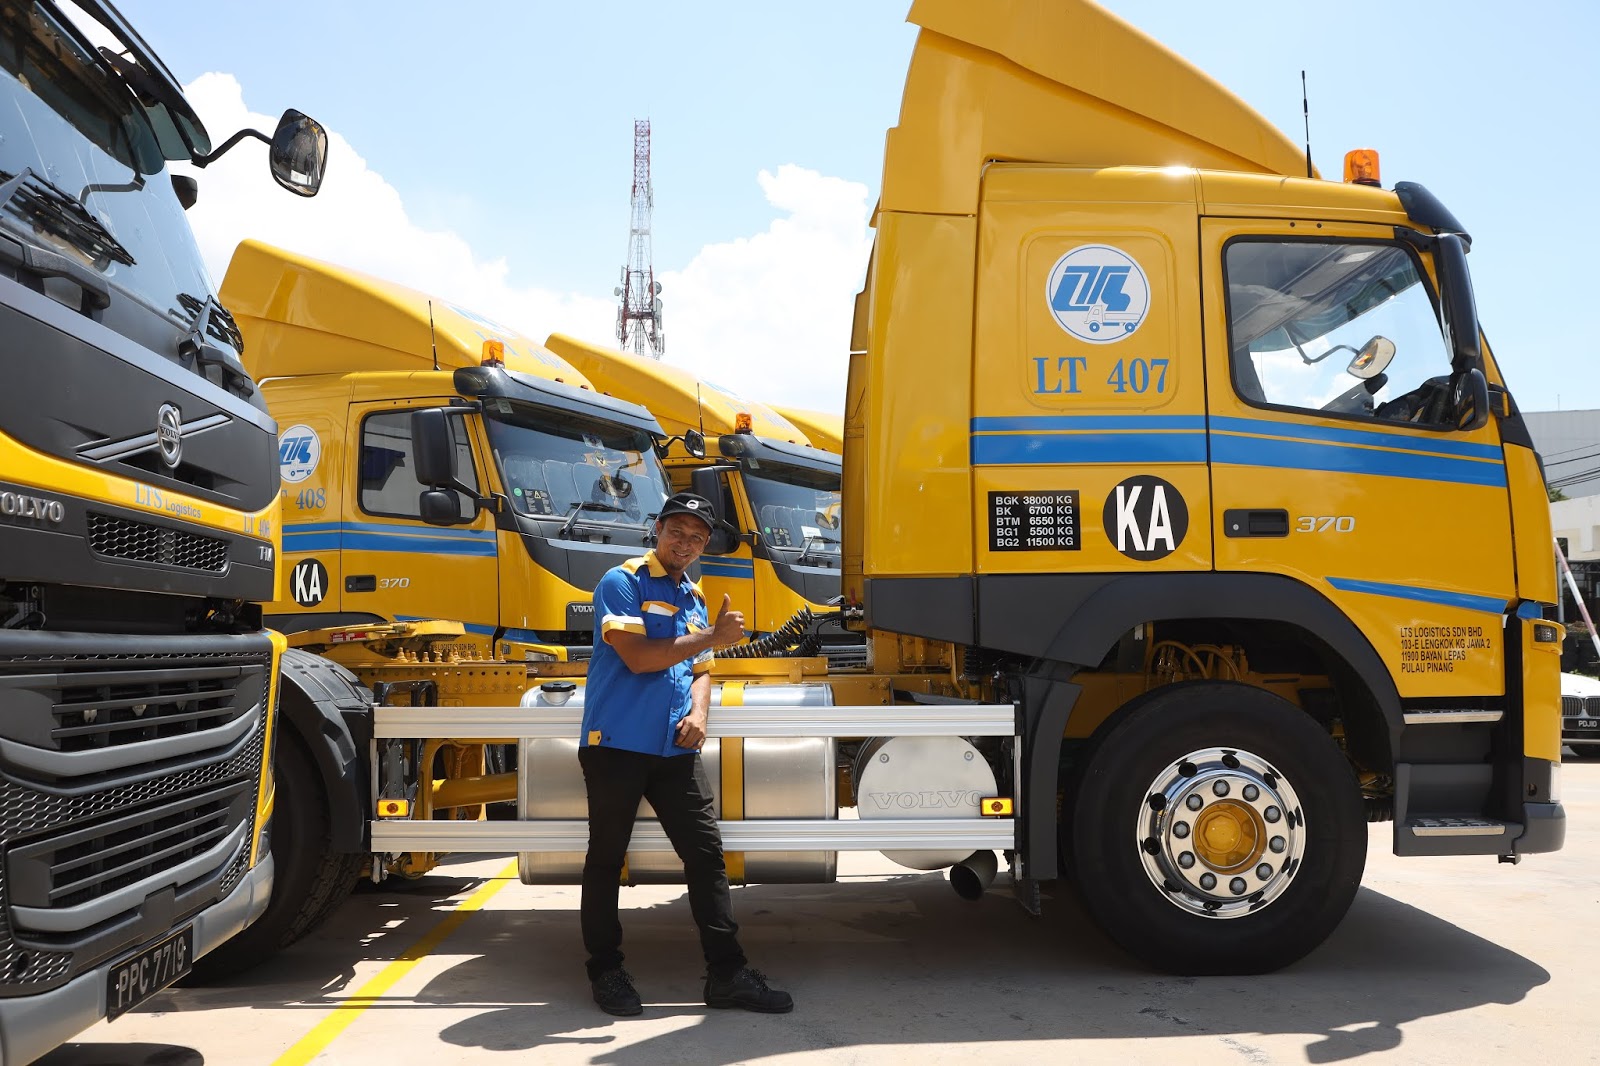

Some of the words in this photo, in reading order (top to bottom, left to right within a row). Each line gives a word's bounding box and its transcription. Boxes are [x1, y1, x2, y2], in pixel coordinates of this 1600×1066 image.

[1033, 356, 1087, 393] LT
[1106, 357, 1169, 393] 407
[134, 482, 162, 509] LTS
[165, 498, 202, 518] Logistics
[295, 487, 326, 510] 408
[995, 496, 1020, 506] BGK
[1023, 495, 1053, 505] 38000
[1056, 495, 1072, 504] KG
[0, 490, 65, 523] OLVO
[996, 506, 1012, 516] BK
[1028, 506, 1053, 515] 6700
[1056, 505, 1073, 515] KG
[996, 517, 1021, 526] BTM
[1029, 516, 1054, 525] 6550
[1057, 516, 1073, 525] KG
[1115, 485, 1176, 551] KA
[1296, 516, 1355, 533] 370
[996, 527, 1018, 537] BG1
[1029, 527, 1055, 536] 5500
[1057, 526, 1074, 536] KG
[997, 538, 1020, 547] BG2
[1026, 537, 1055, 547] 11500
[1057, 536, 1074, 546] KG
[295, 563, 322, 603] KA
[379, 577, 410, 589] 370
[571, 605, 596, 613] VOLV
[1400, 627, 1413, 638] LTS
[1414, 627, 1451, 638] LOGISTICS
[1452, 626, 1467, 637] SDN
[1468, 626, 1483, 637] BHD
[1401, 639, 1419, 649] 103-E
[1421, 639, 1454, 649] LENGKOK
[1455, 639, 1465, 649] KG
[1467, 638, 1486, 649] JAWA
[1486, 638, 1491, 648] 2
[1401, 651, 1419, 662] 11900
[1420, 650, 1443, 661] BAYAN
[1444, 650, 1466, 661] LEPAS
[1401, 662, 1425, 673] PULAU
[1427, 662, 1454, 673] PINANG
[118, 957, 149, 1008] PPC
[152, 936, 185, 988] 7719
